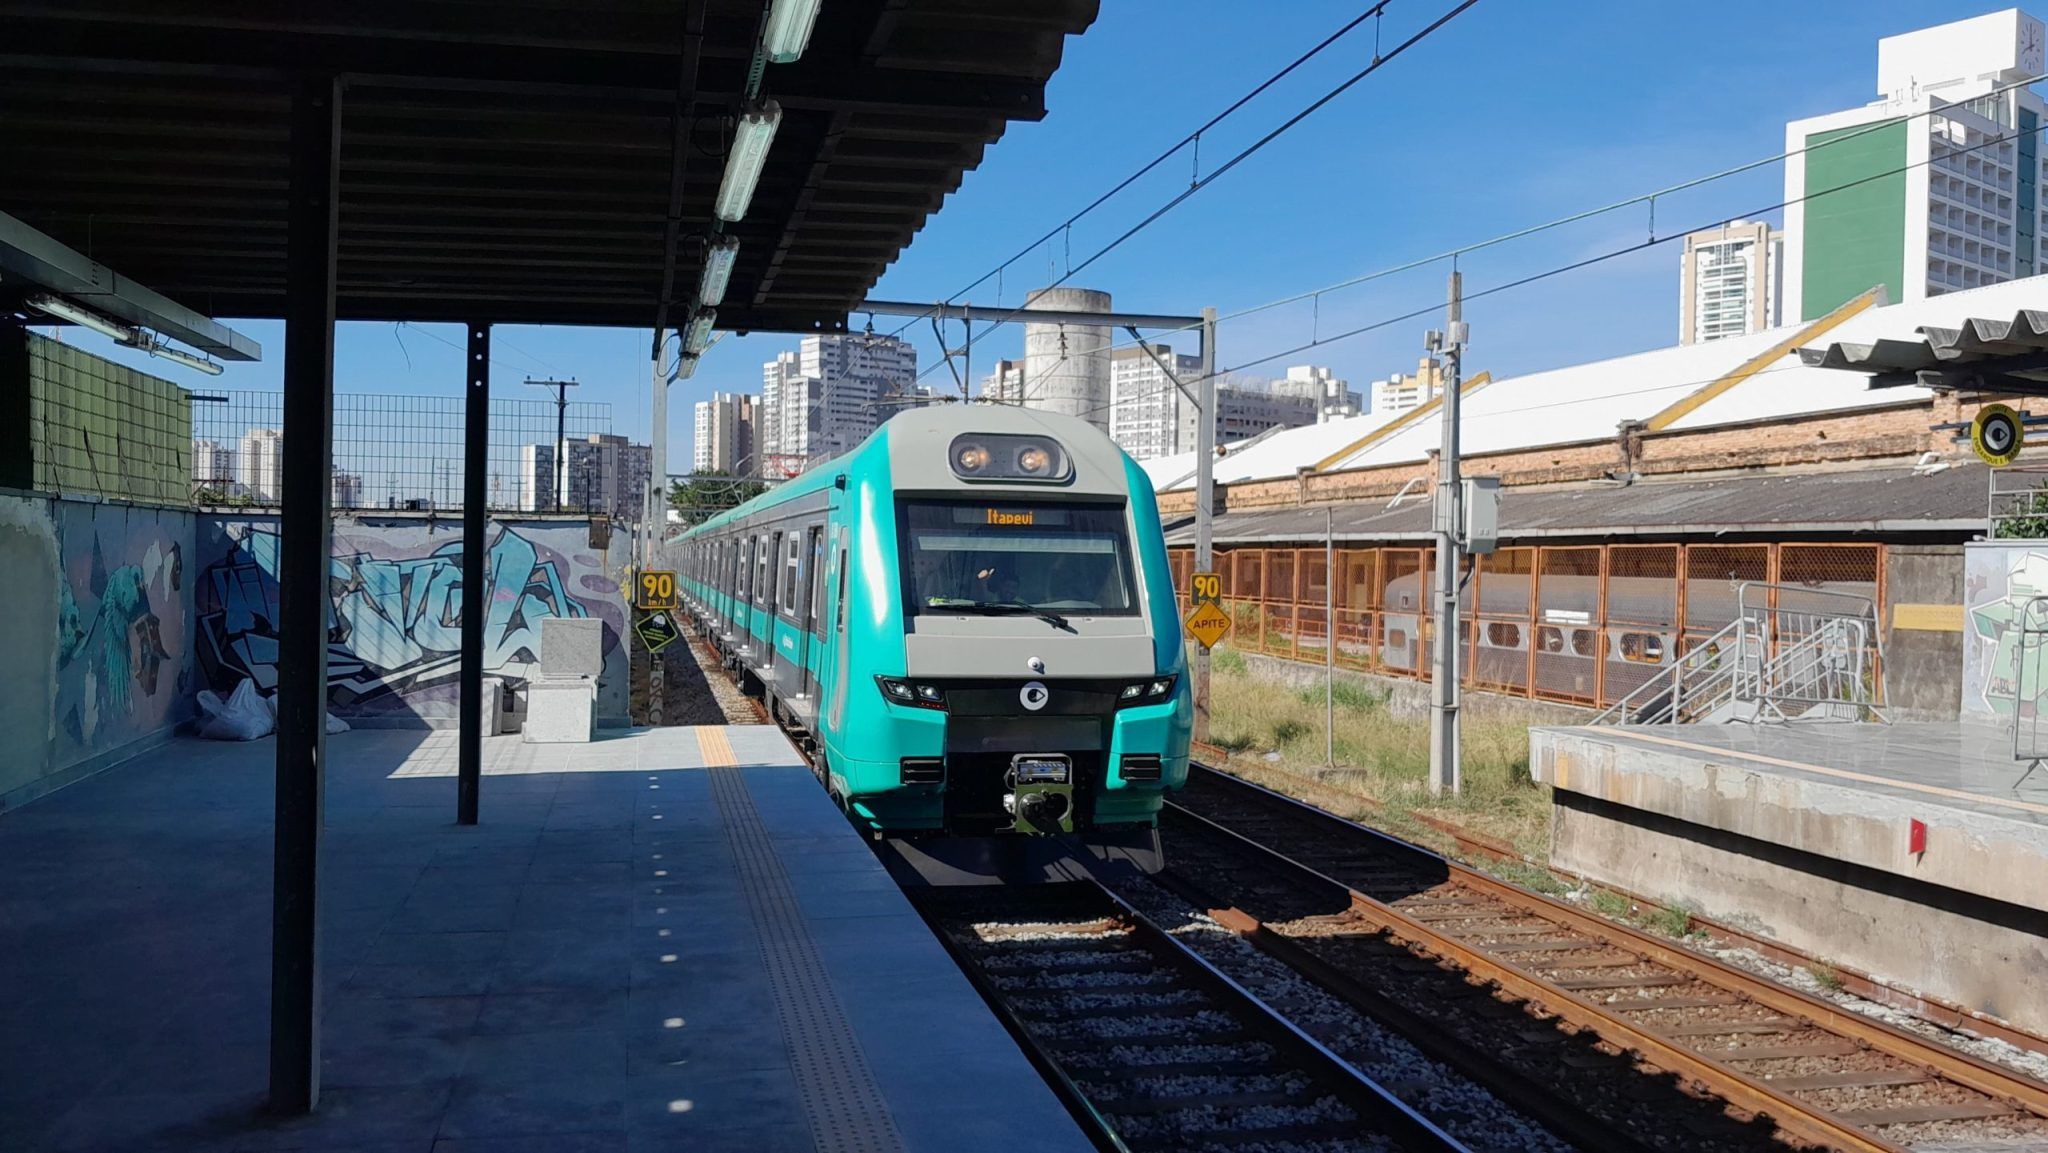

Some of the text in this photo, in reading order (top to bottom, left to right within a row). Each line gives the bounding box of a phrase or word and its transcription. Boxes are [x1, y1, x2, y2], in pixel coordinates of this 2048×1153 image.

[987, 508, 1033, 525] Itapevi
[643, 574, 672, 598] 90
[1194, 576, 1219, 598] 90
[1193, 618, 1225, 629] APITE
